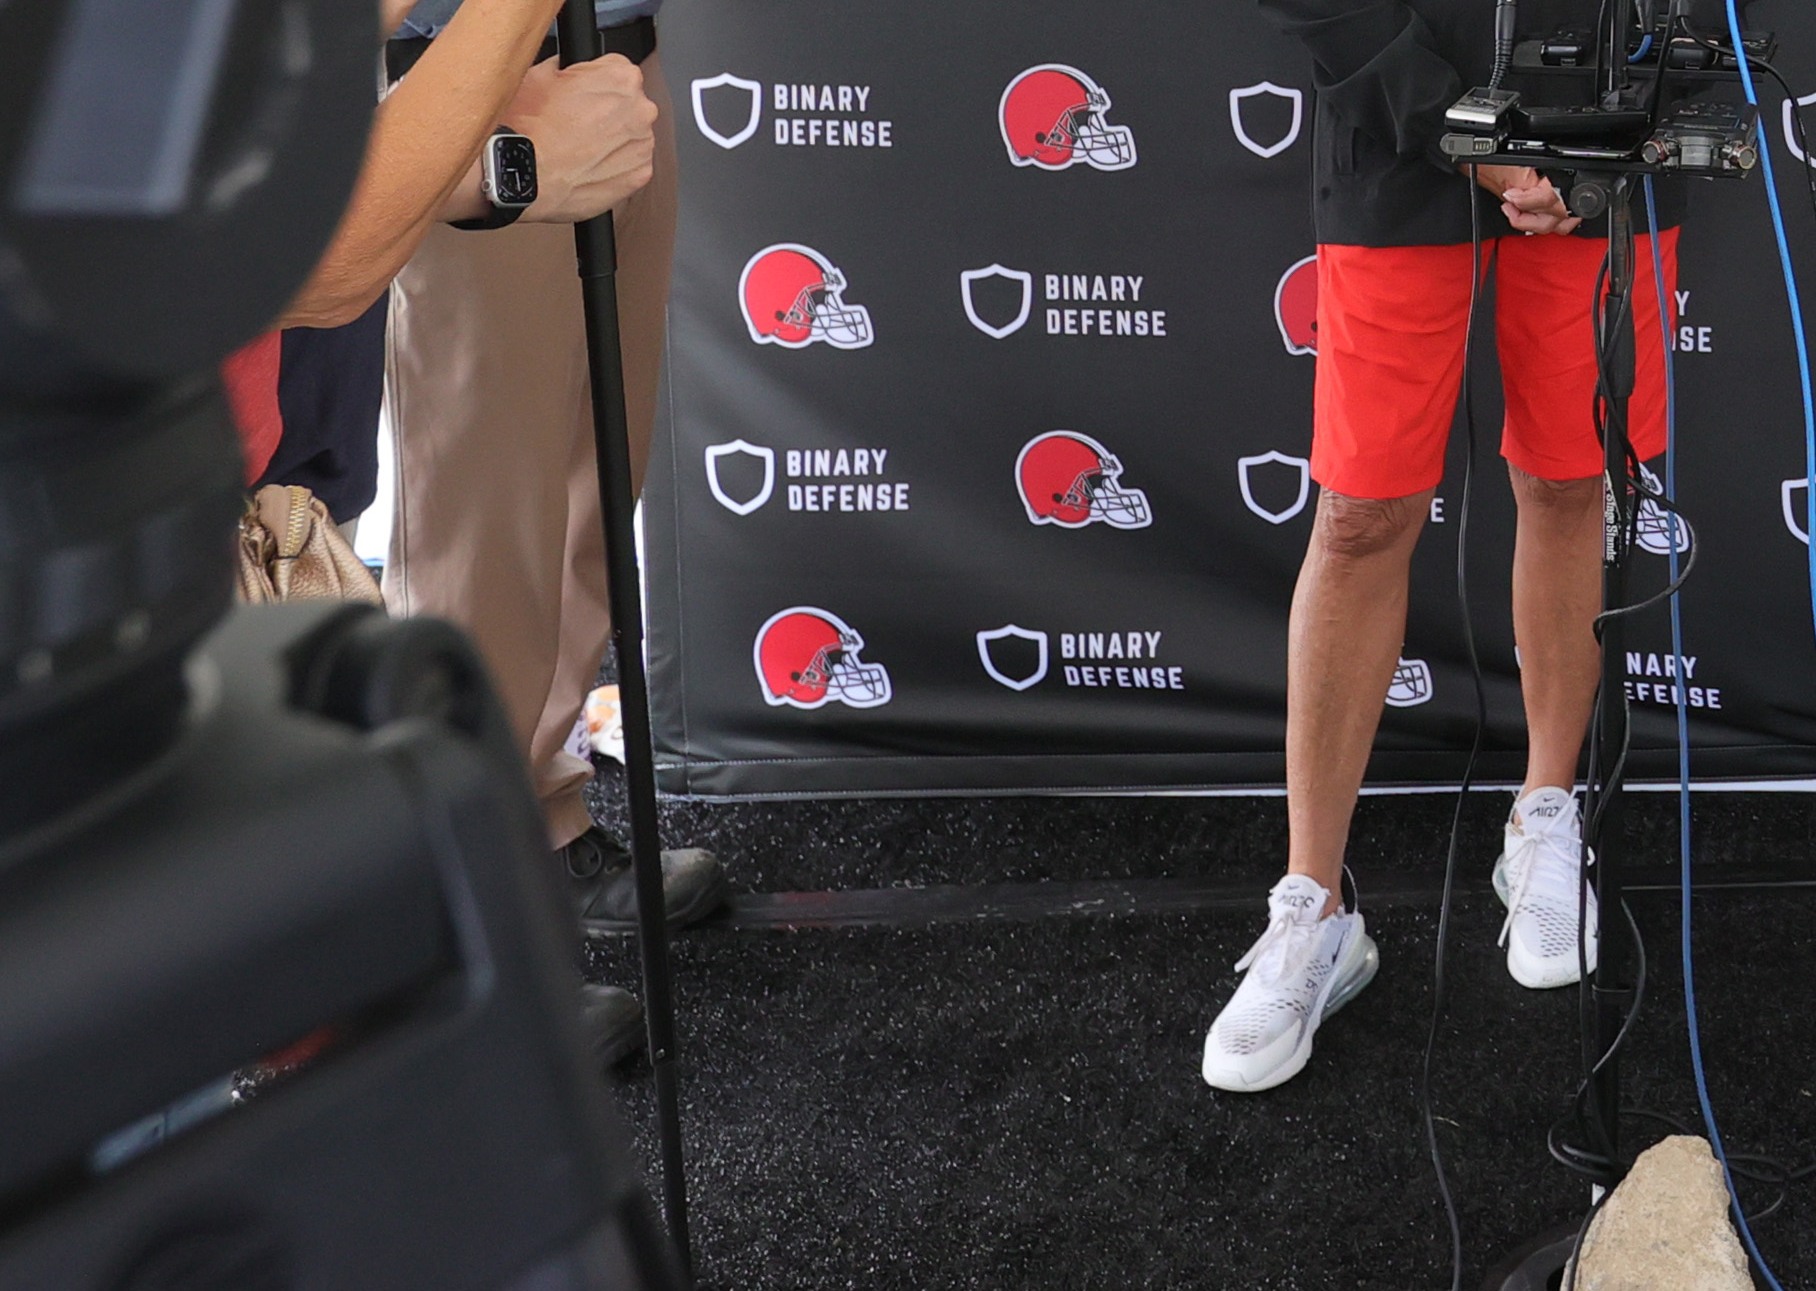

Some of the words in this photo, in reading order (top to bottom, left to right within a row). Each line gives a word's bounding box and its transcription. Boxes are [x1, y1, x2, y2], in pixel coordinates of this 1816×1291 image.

[774, 83, 870, 112] BINARY
[775, 118, 892, 147] DEFENSE
[1045, 274, 1143, 302] BINARY
[1046, 308, 1167, 336] DEFENSE
[786, 449, 887, 477] BINARY
[788, 483, 909, 512] DEFENSE
[1061, 631, 1161, 659] BINARY
[1064, 665, 1184, 689] DEFENSE
[1626, 652, 1697, 679] NARY
